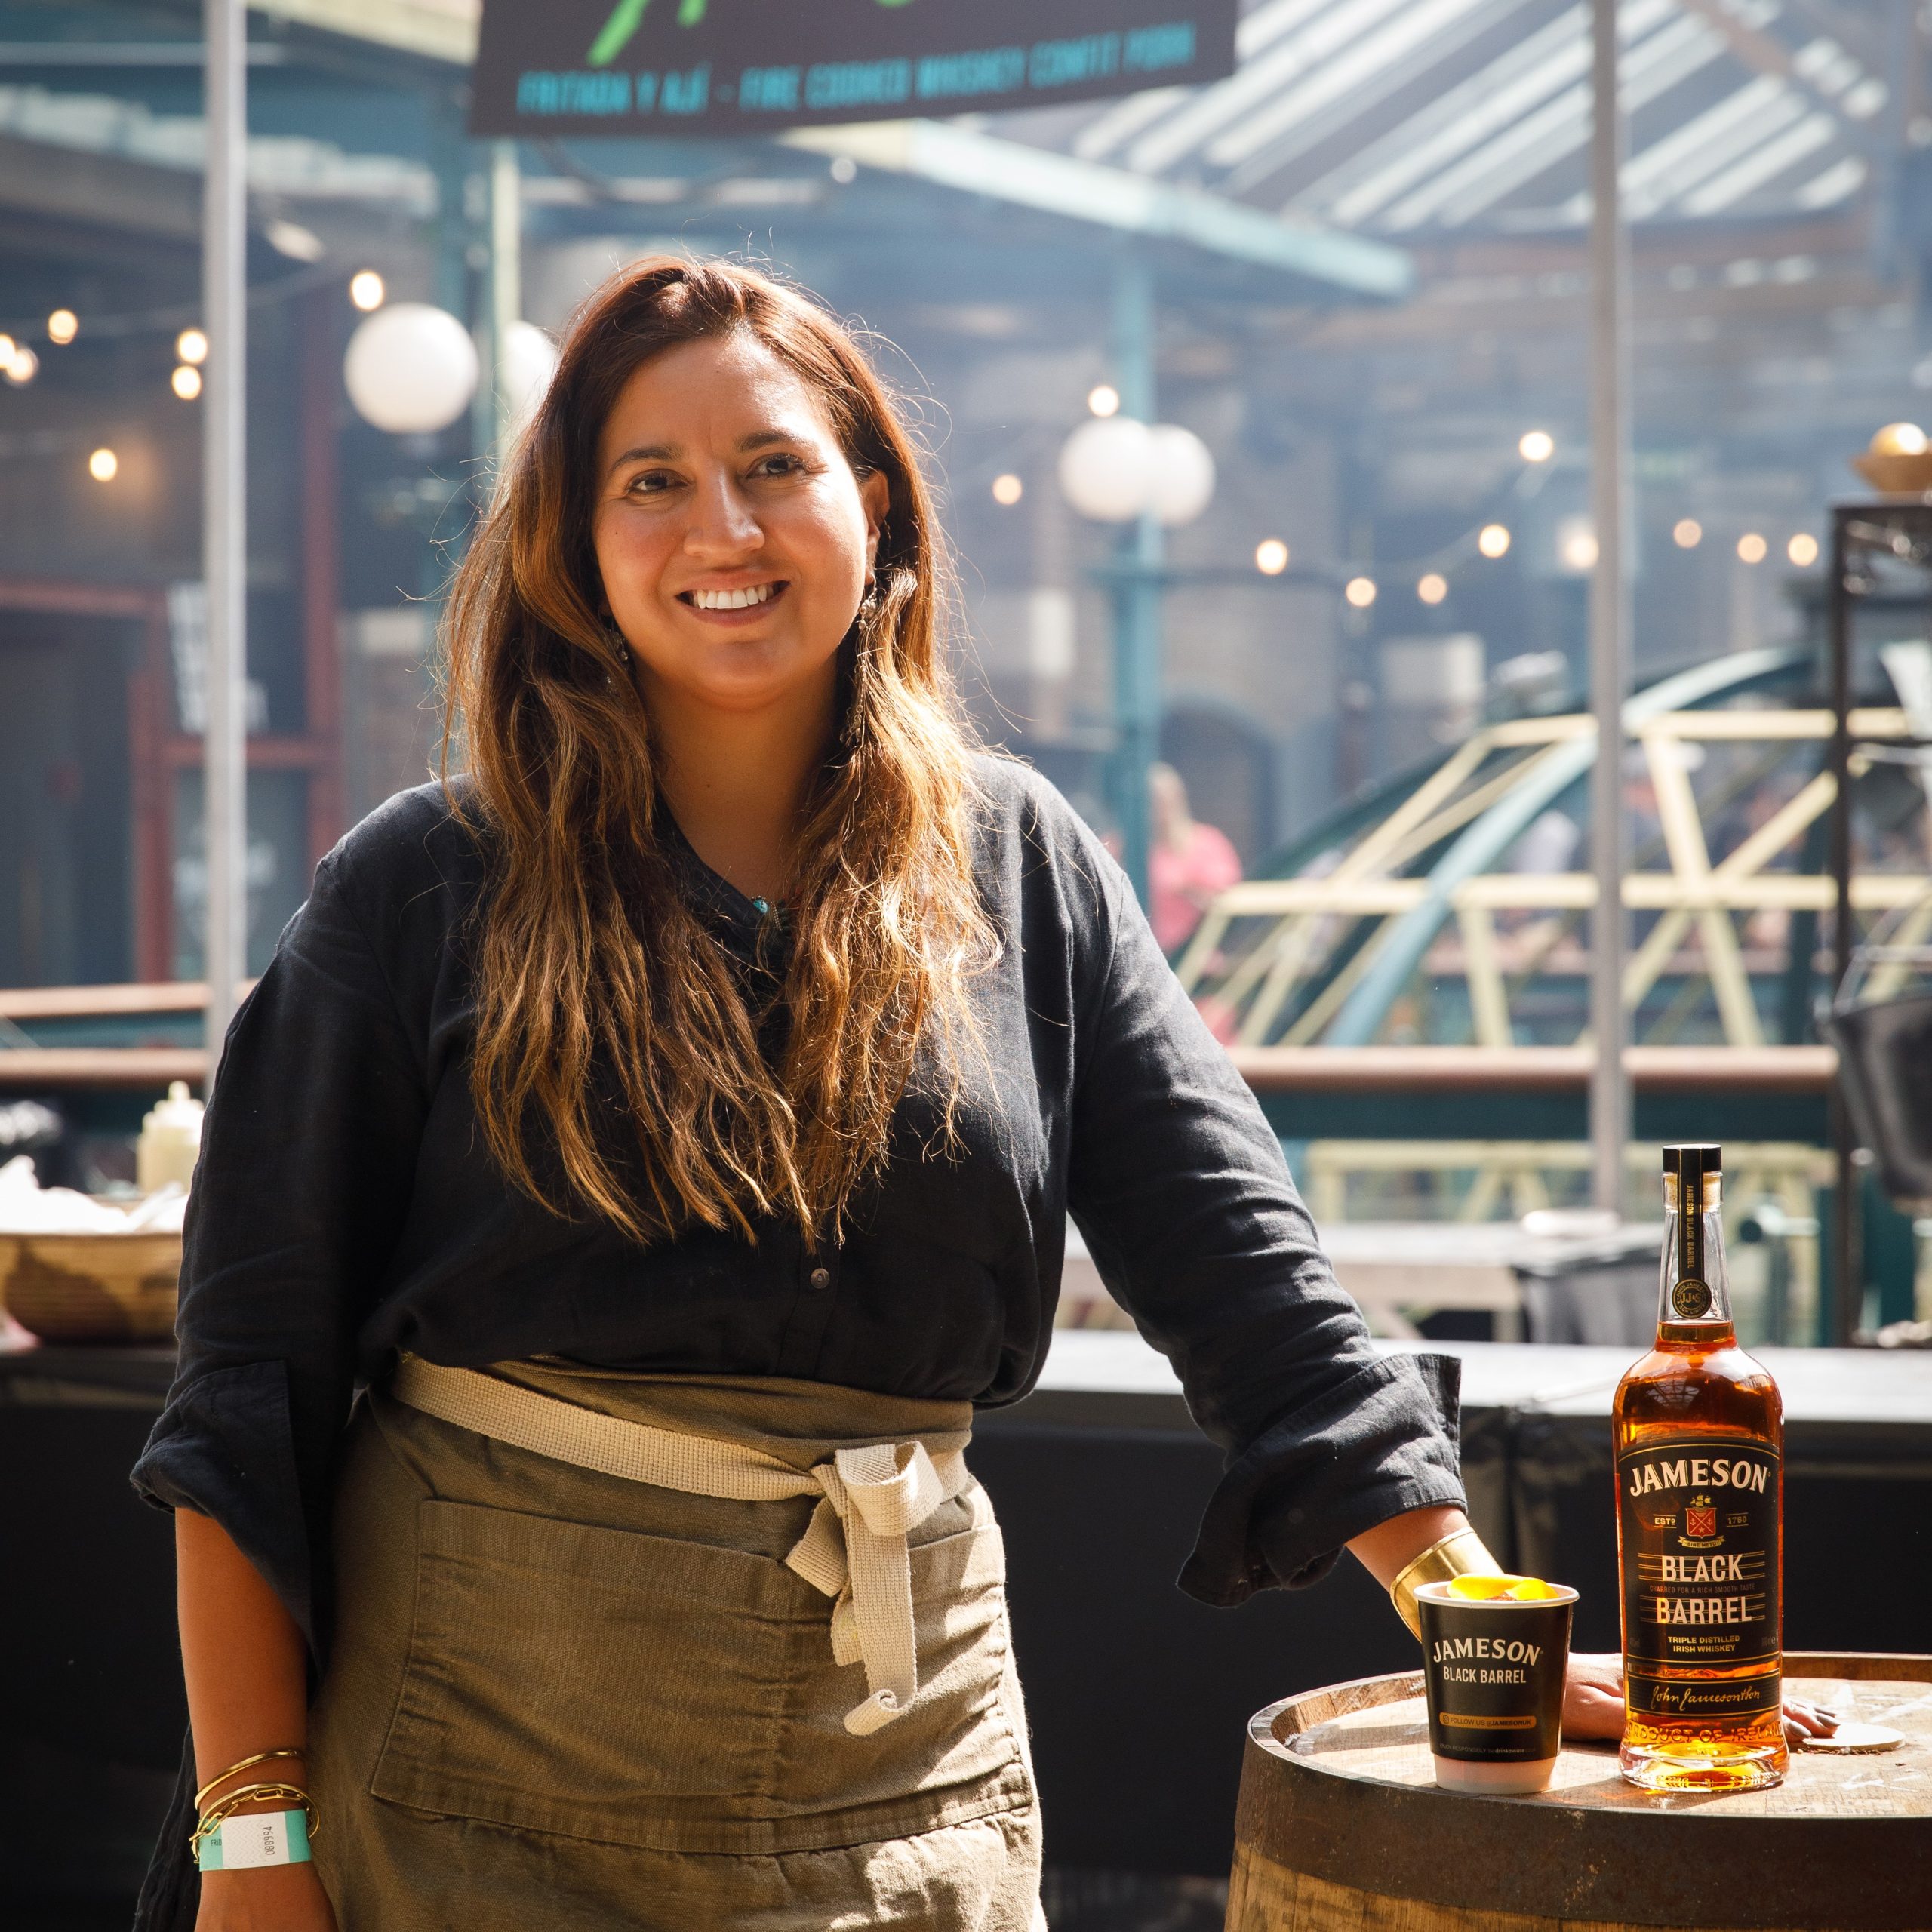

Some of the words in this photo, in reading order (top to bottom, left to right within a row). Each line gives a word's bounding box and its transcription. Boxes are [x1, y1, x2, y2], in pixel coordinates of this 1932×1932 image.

[1686, 1184, 1694, 1216] JAMESON
[1687, 1241, 1695, 1269] BARREL
[1630, 1459, 1768, 1497] JAMESON
[1727, 1516, 1747, 1524] 1780
[1662, 1554, 1743, 1583] BLACK
[1650, 1585, 1675, 1593] CHARRED
[1677, 1586, 1690, 1594] FOR
[1697, 1586, 1712, 1594] RICH
[1714, 1585, 1738, 1593] SMOOTH
[1656, 1596, 1752, 1624] BARREL
[1434, 1638, 1541, 1666] JAMESON
[1697, 1644, 1736, 1653] WHISKEY
[1444, 1666, 1477, 1683] BLACK
[1480, 1668, 1527, 1684] BARREL
[1450, 1717, 1475, 1726] FOLLOW
[263, 1826, 275, 1856] 088994
